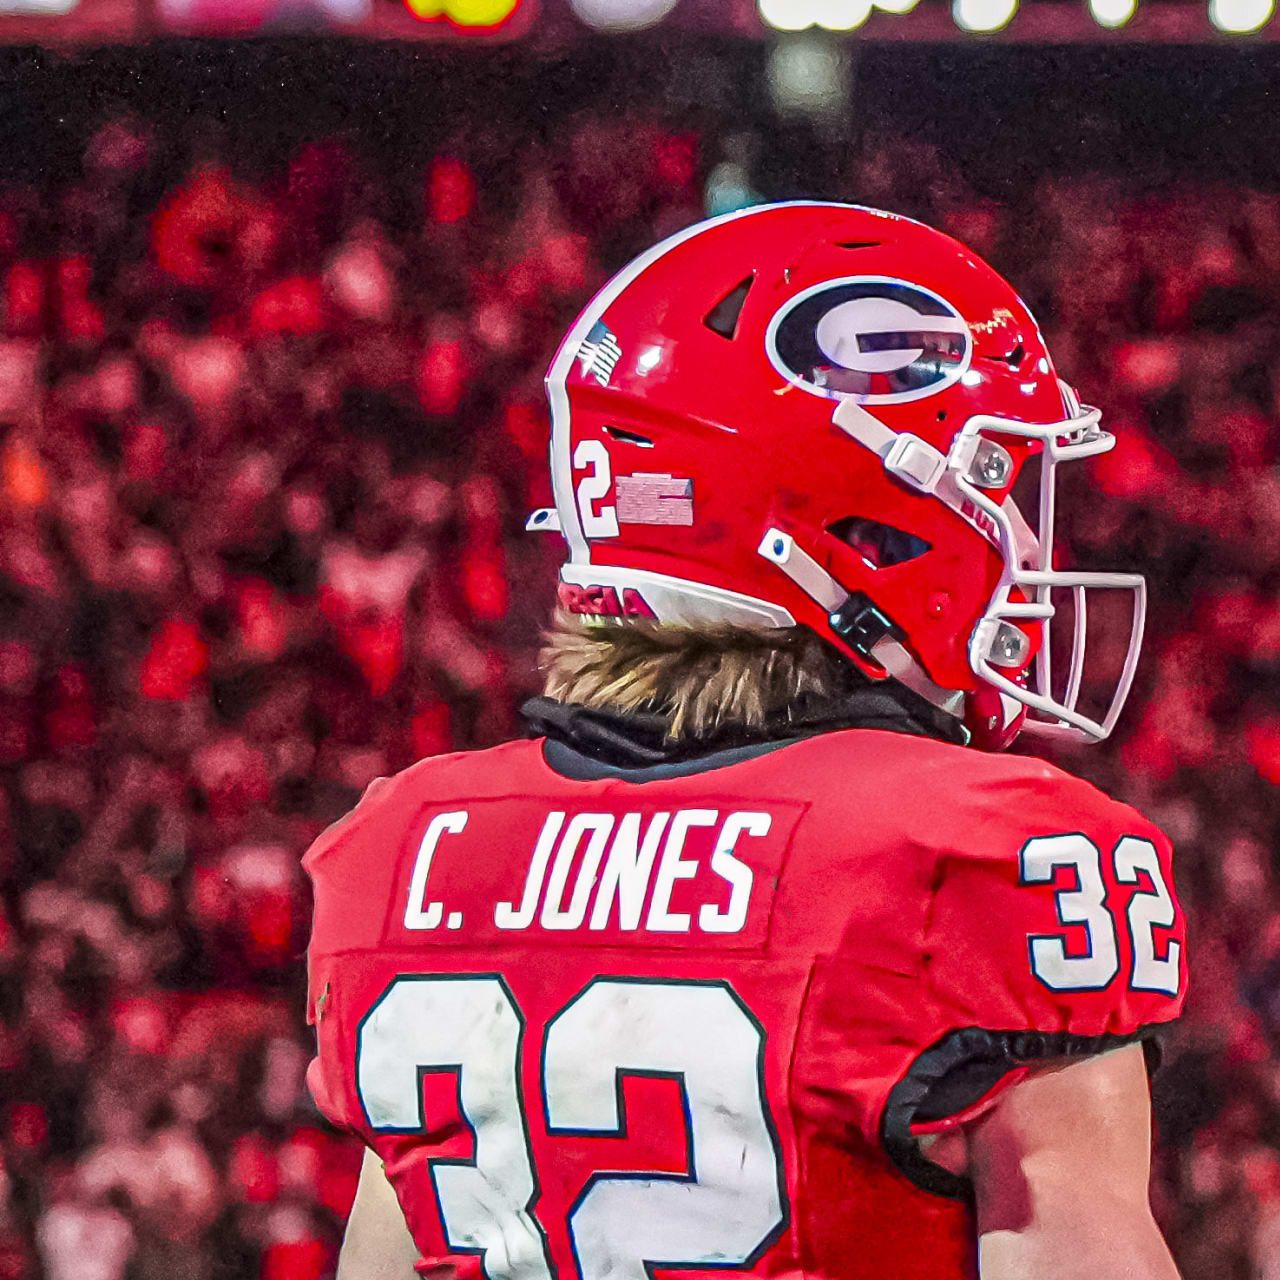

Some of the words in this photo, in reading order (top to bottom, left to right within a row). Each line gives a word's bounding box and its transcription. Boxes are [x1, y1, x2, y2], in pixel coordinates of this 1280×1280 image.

[403, 811, 469, 930] C.
[493, 808, 773, 933] JONES
[1018, 831, 1181, 998] 32
